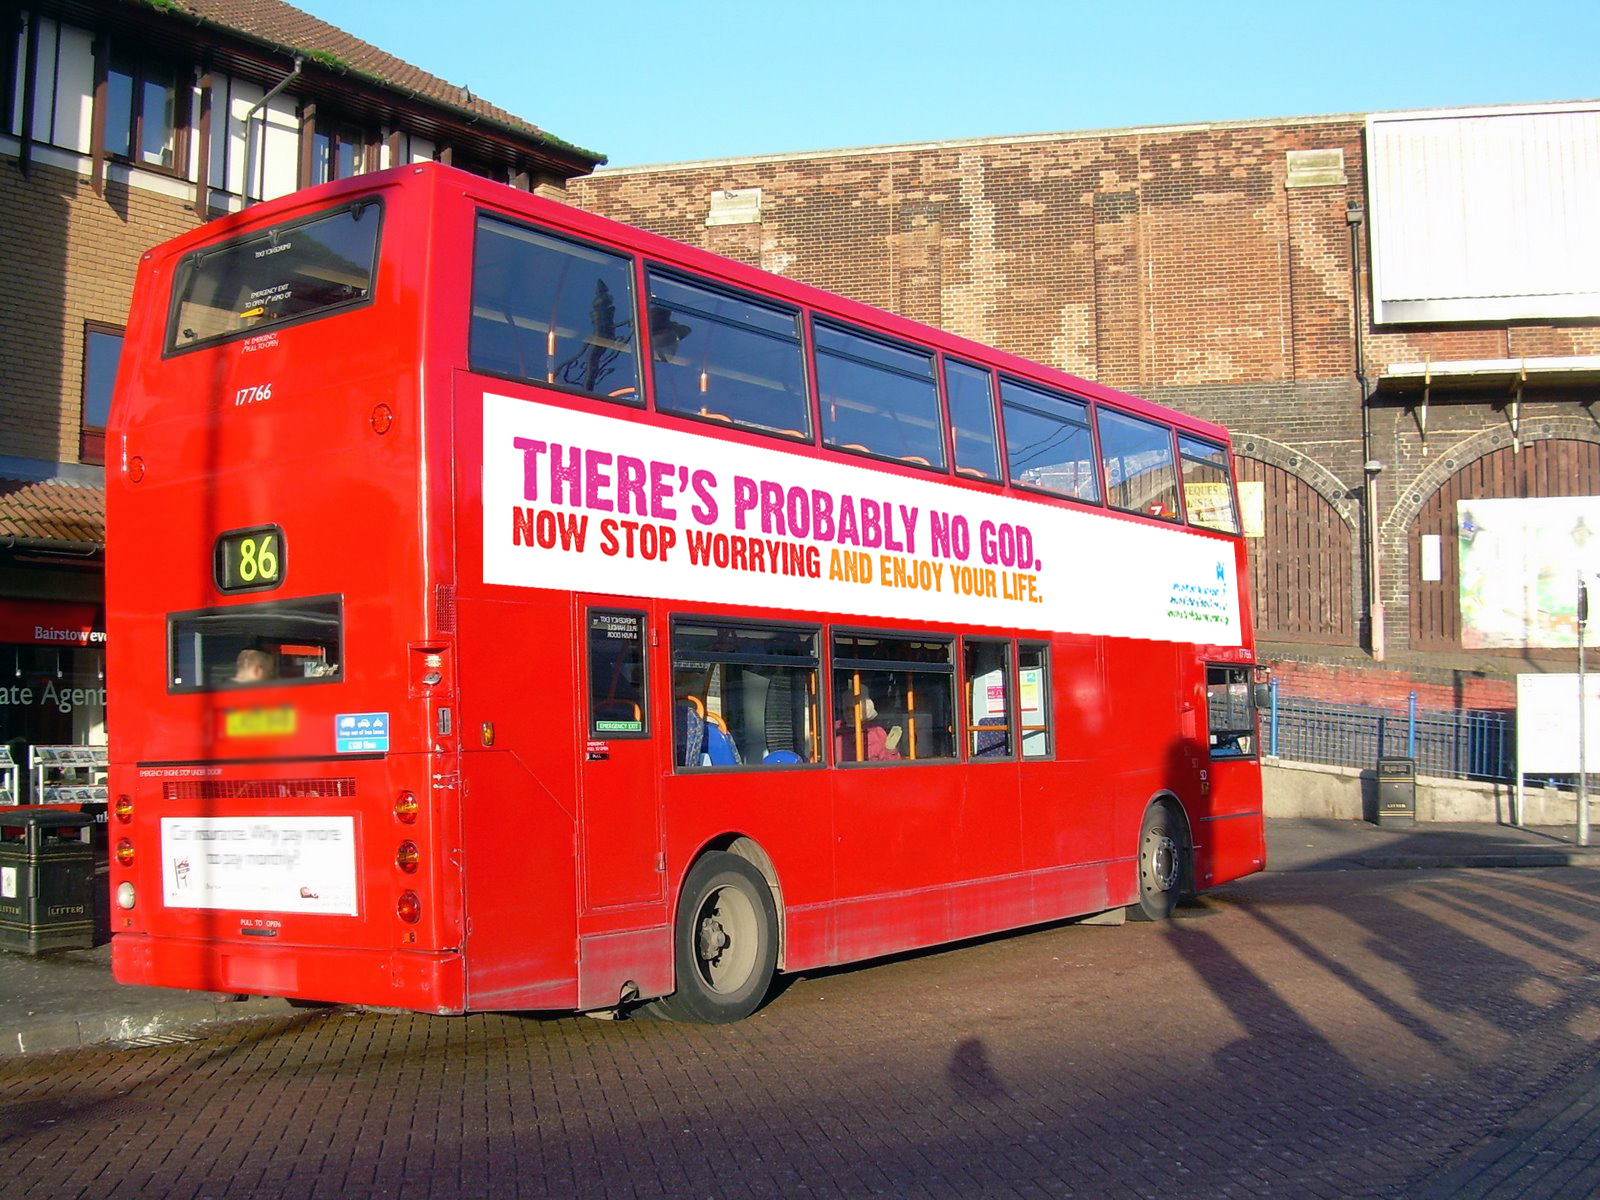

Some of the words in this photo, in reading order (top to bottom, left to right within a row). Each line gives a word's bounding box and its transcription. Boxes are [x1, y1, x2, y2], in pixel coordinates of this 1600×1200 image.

[235, 383, 272, 406] 17766
[513, 436, 719, 526] THERE'S
[733, 475, 919, 554] PROBABLY
[930, 510, 970, 561] NO
[980, 520, 1042, 571] GOD.
[240, 535, 277, 582] 86
[512, 506, 588, 553] NOW
[600, 518, 677, 562] STOP
[686, 529, 821, 579] WORRYING
[829, 548, 873, 584] AND
[880, 554, 943, 592] ENJOY
[950, 564, 998, 598] YOUR
[1002, 571, 1043, 603] LIFE.
[50, 905, 83, 916] LITTER
[240, 918, 253, 926] PULL
[255, 919, 263, 927] TO
[266, 920, 282, 928] OPEN
